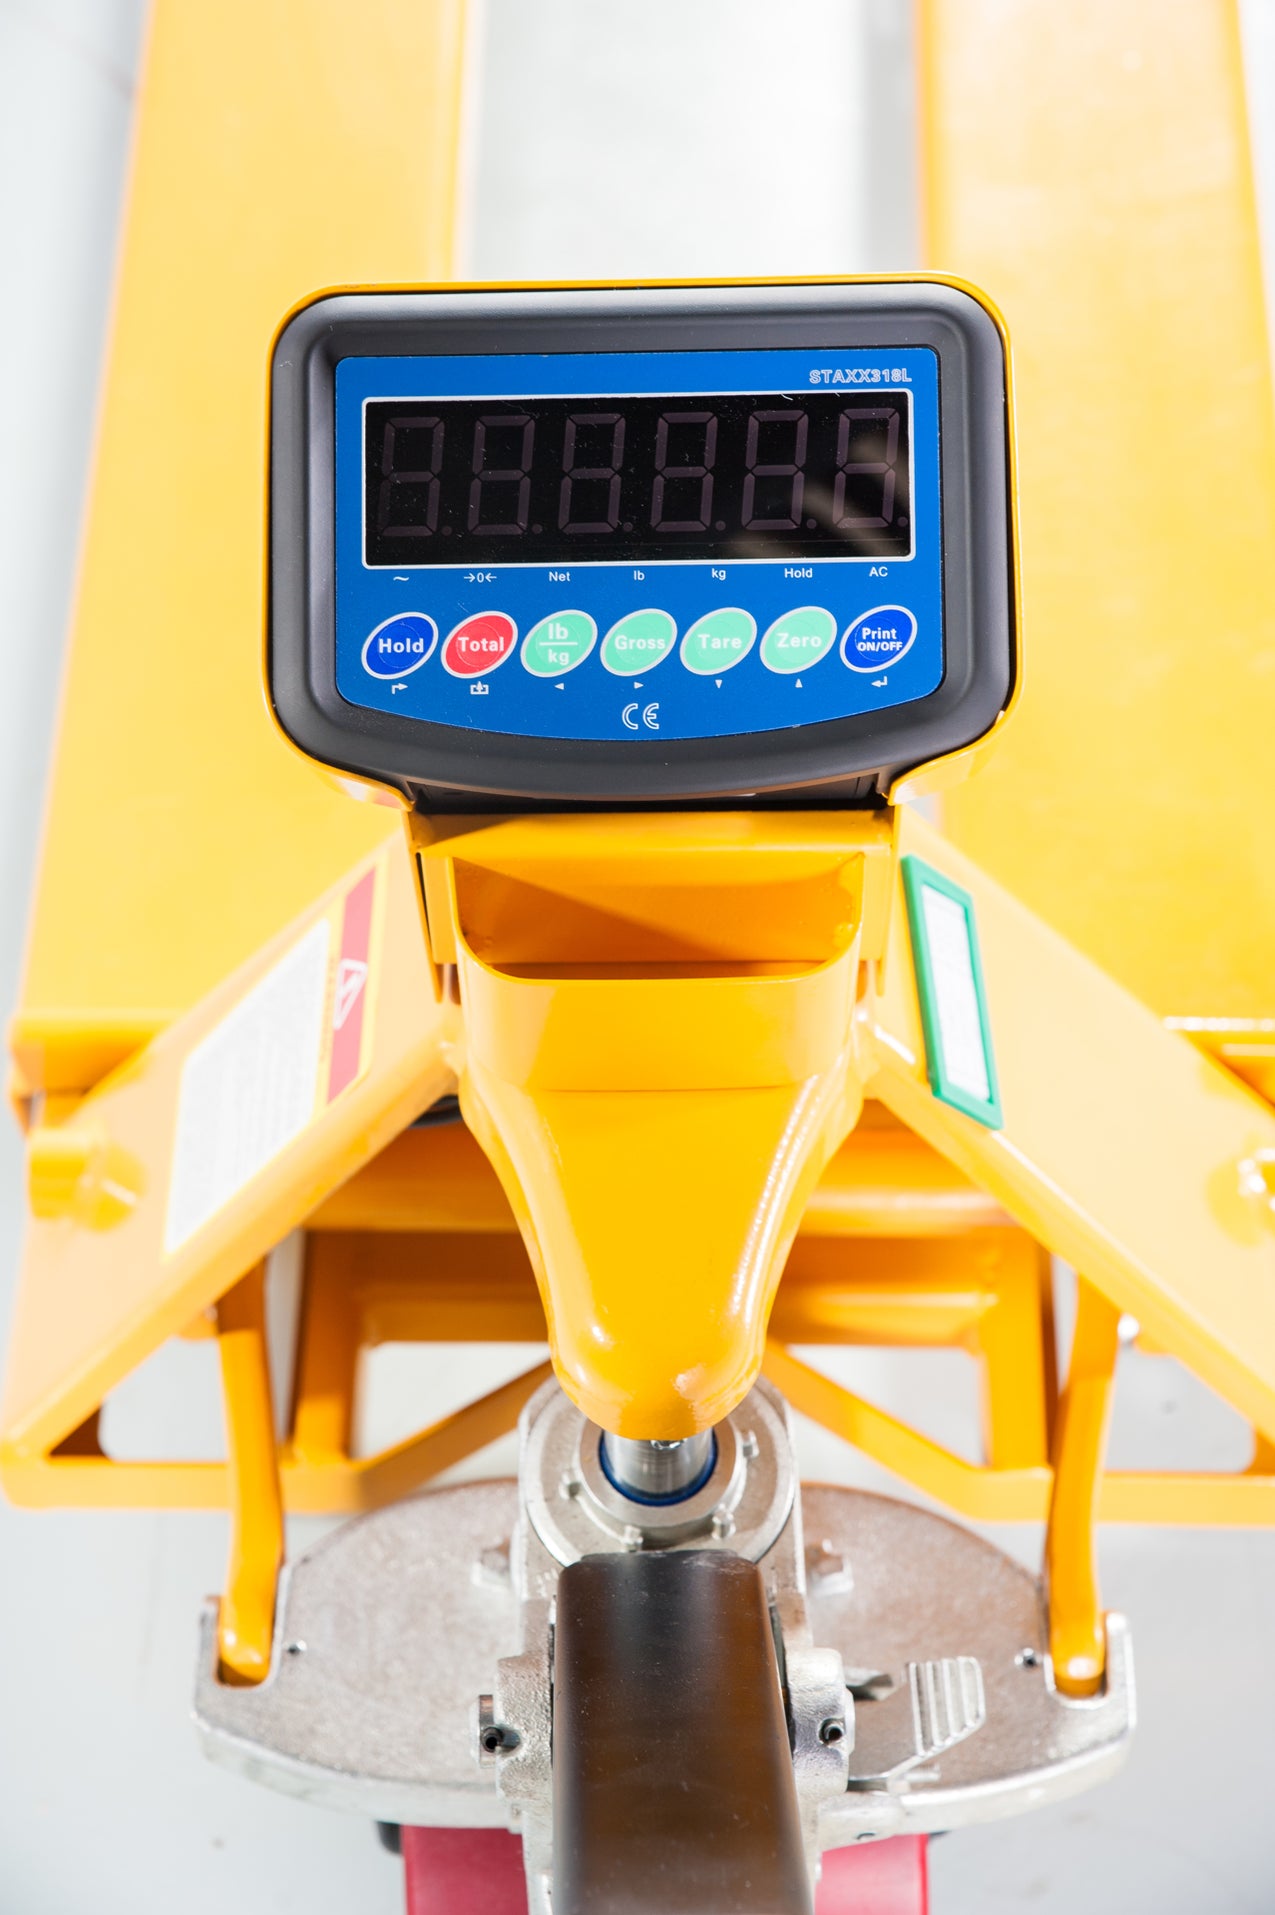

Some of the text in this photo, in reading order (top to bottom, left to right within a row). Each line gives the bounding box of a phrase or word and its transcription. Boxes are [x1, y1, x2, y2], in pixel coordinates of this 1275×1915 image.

[808, 367, 913, 384] STAXX318L
[548, 571, 571, 582] Net
[711, 568, 726, 581] kg
[784, 567, 813, 579] Hold
[869, 566, 889, 577] AC
[548, 622, 569, 639] lb
[861, 627, 897, 640] Print
[378, 637, 425, 654] Hold
[458, 636, 505, 653] Total
[614, 635, 666, 650] Gross
[699, 634, 742, 650] Tare
[777, 633, 822, 648] Zero
[856, 641, 904, 652] ON/OFF
[548, 650, 570, 666] kg
